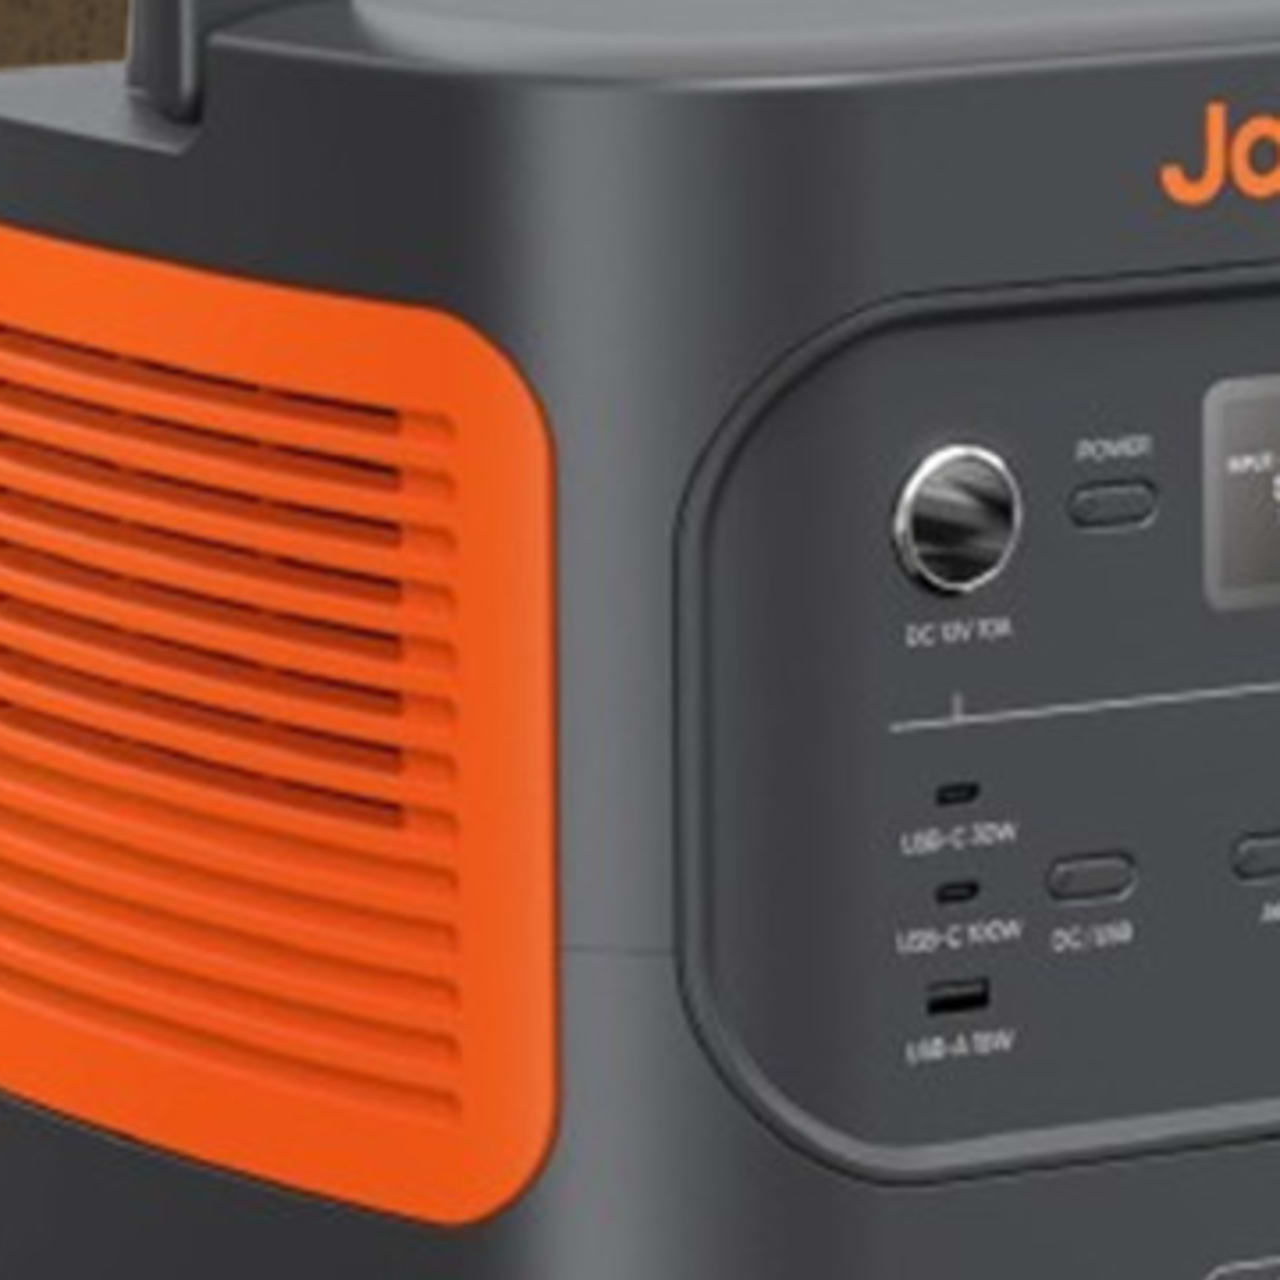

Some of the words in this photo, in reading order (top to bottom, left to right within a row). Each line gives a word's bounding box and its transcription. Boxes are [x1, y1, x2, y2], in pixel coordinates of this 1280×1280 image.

[1076, 433, 1154, 463] POWER
[904, 622, 936, 648] DC
[900, 824, 965, 857] USB-C
[895, 922, 963, 955] USB-C
